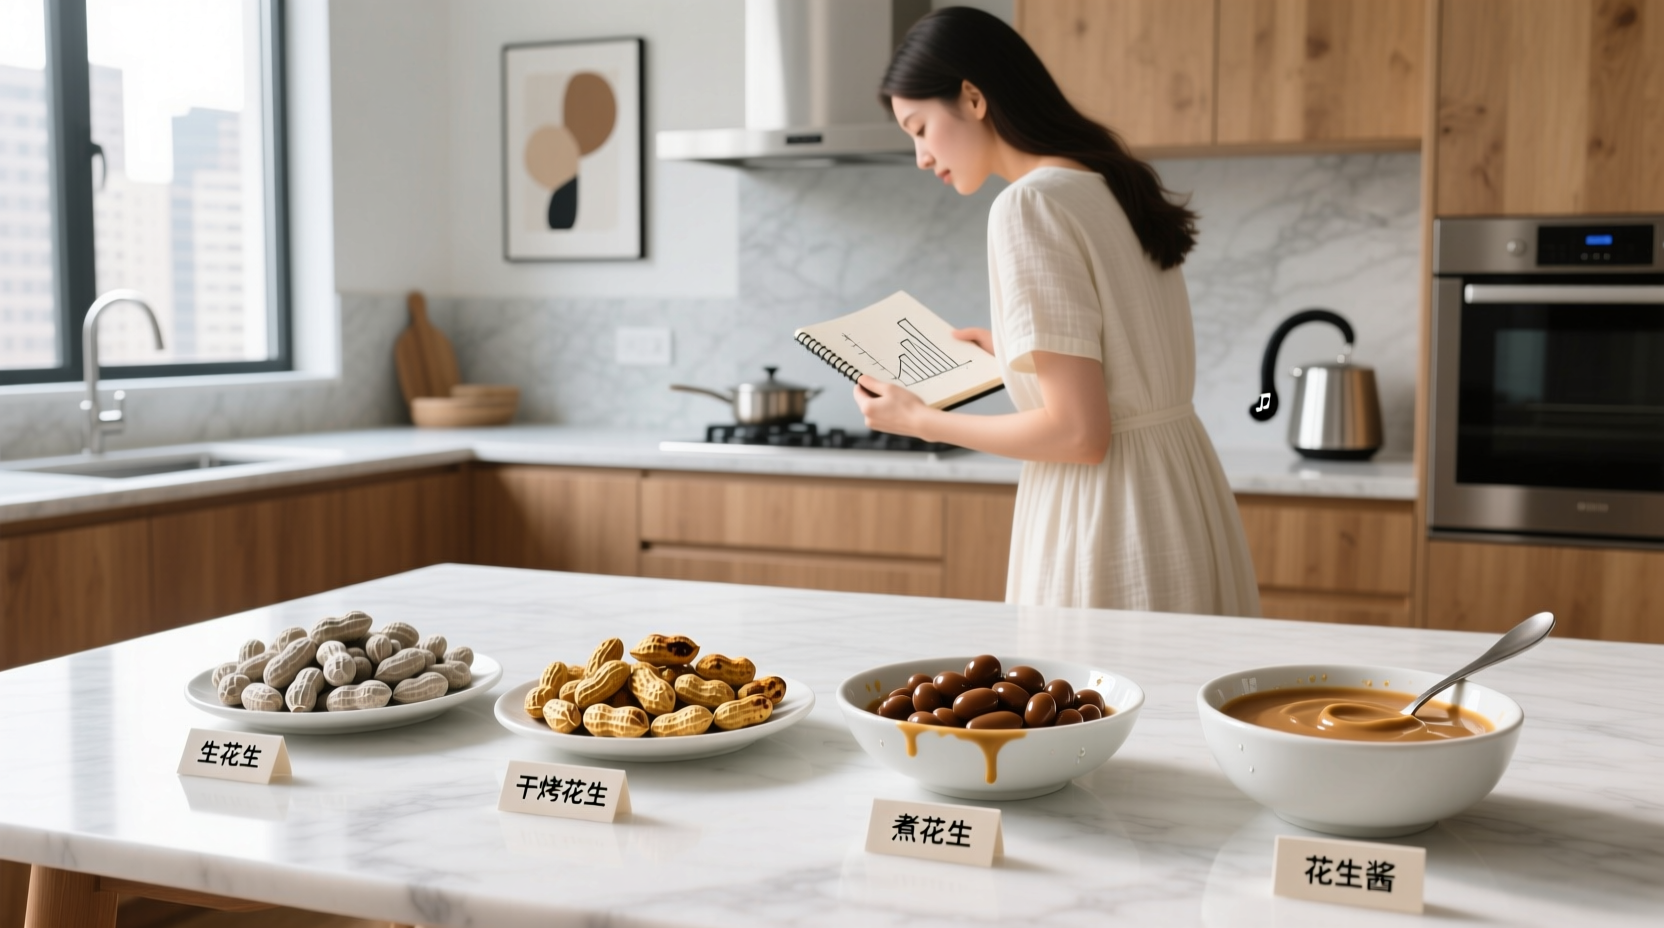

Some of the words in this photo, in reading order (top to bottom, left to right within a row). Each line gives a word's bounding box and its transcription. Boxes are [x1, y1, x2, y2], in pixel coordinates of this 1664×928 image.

[197, 740, 262, 768] 生花生
[516, 774, 608, 807] 干烤花生
[891, 813, 973, 848] 煮花生
[1304, 854, 1396, 893] 花生酱
